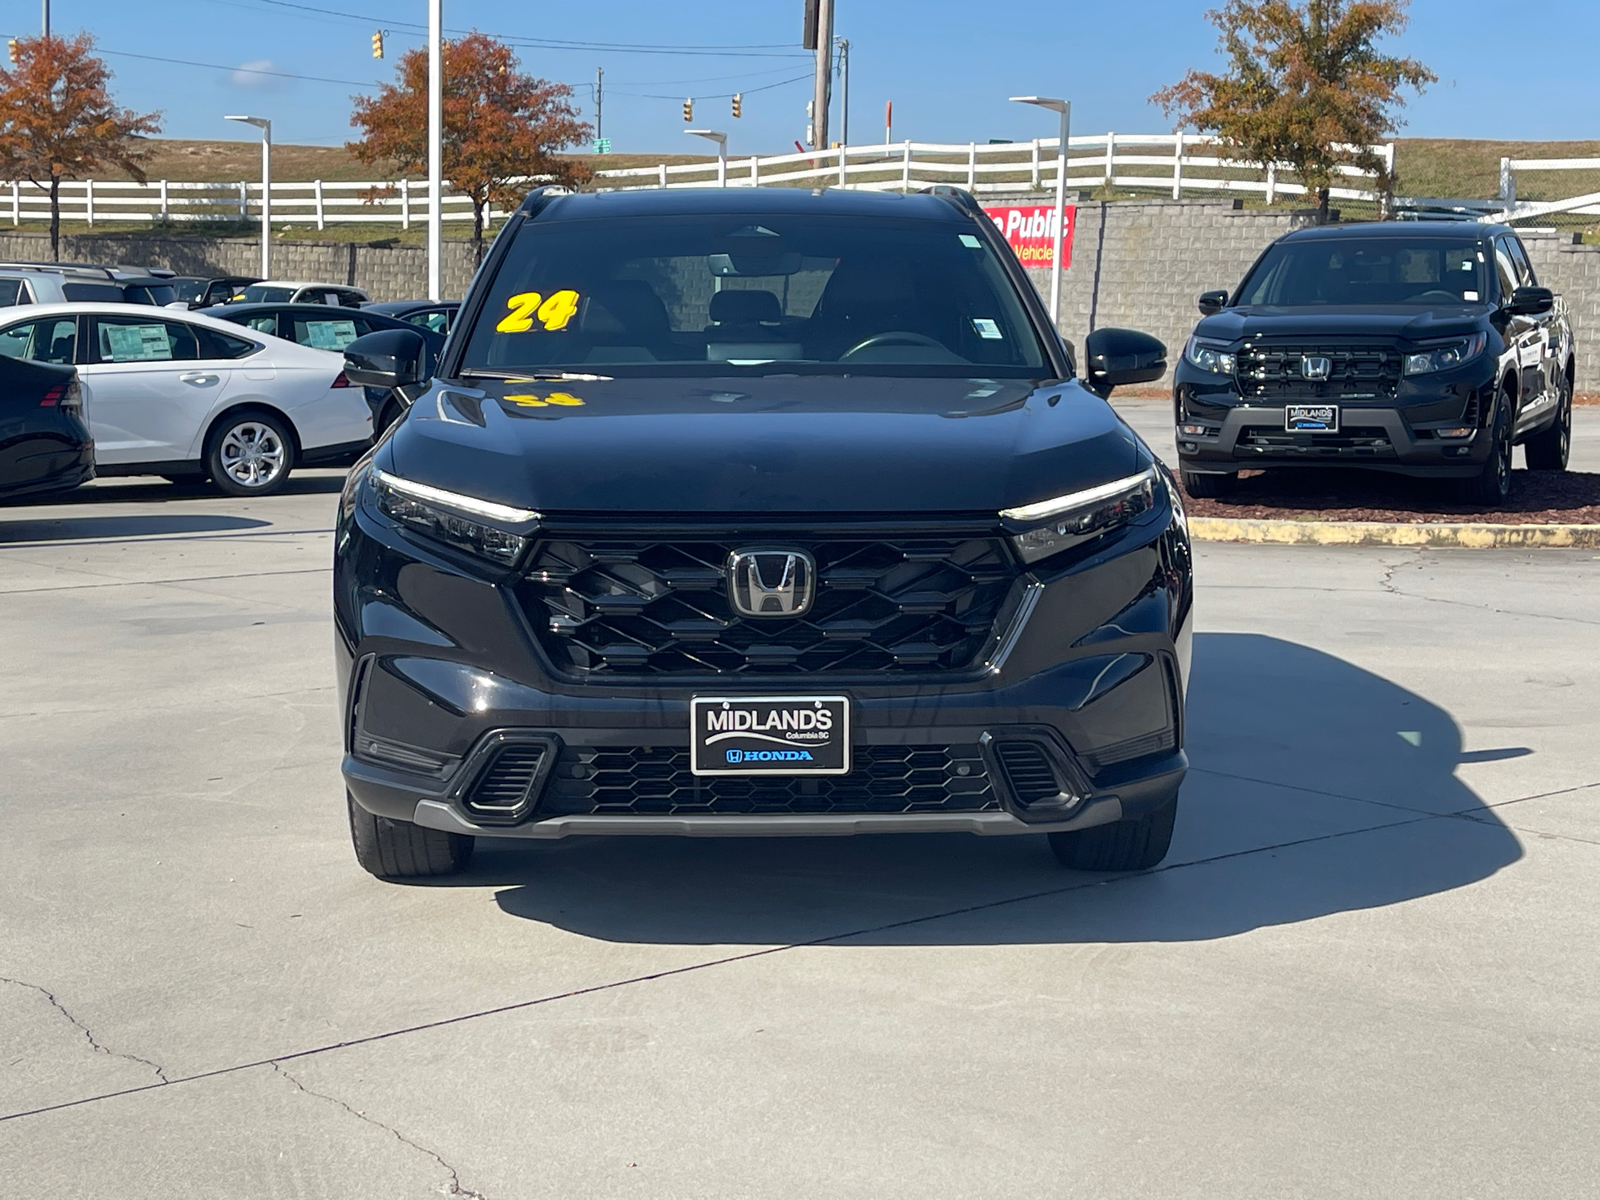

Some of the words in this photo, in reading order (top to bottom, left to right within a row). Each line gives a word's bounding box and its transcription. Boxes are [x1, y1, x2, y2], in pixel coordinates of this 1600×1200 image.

[1015, 244, 1058, 260] Vehicle
[496, 290, 580, 333] 24
[1290, 409, 1333, 417] MIDLANDS
[707, 709, 833, 731] MIDLANDS
[785, 731, 818, 740] Columbia
[818, 731, 830, 740] SC
[743, 750, 814, 761] HONDA
